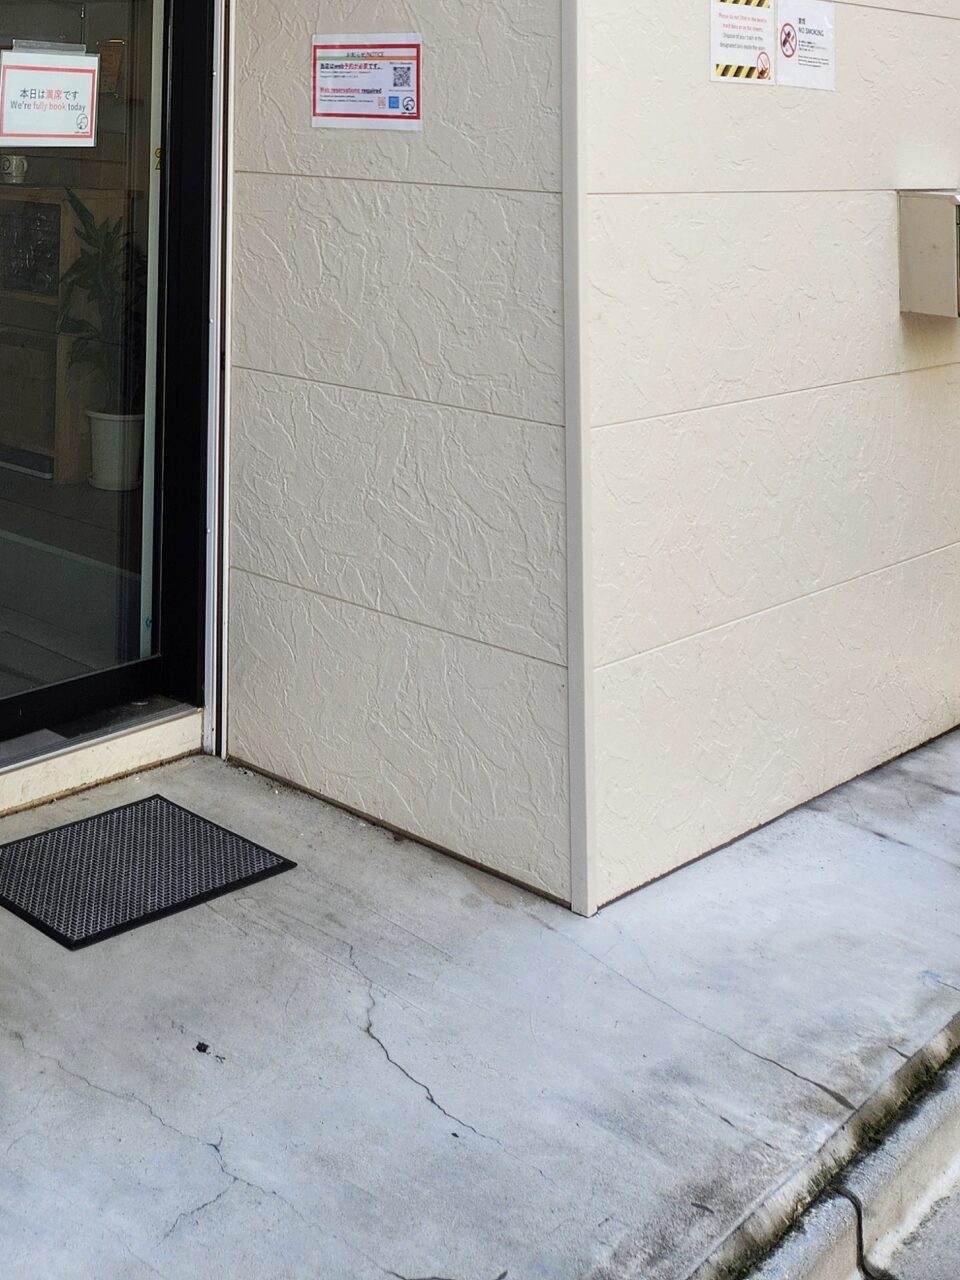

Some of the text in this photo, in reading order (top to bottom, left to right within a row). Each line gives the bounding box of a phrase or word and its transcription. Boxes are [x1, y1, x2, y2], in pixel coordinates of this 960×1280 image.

[19, 88, 79, 100] 本日は満席です
[10, 101, 86, 113] We're fully book today
